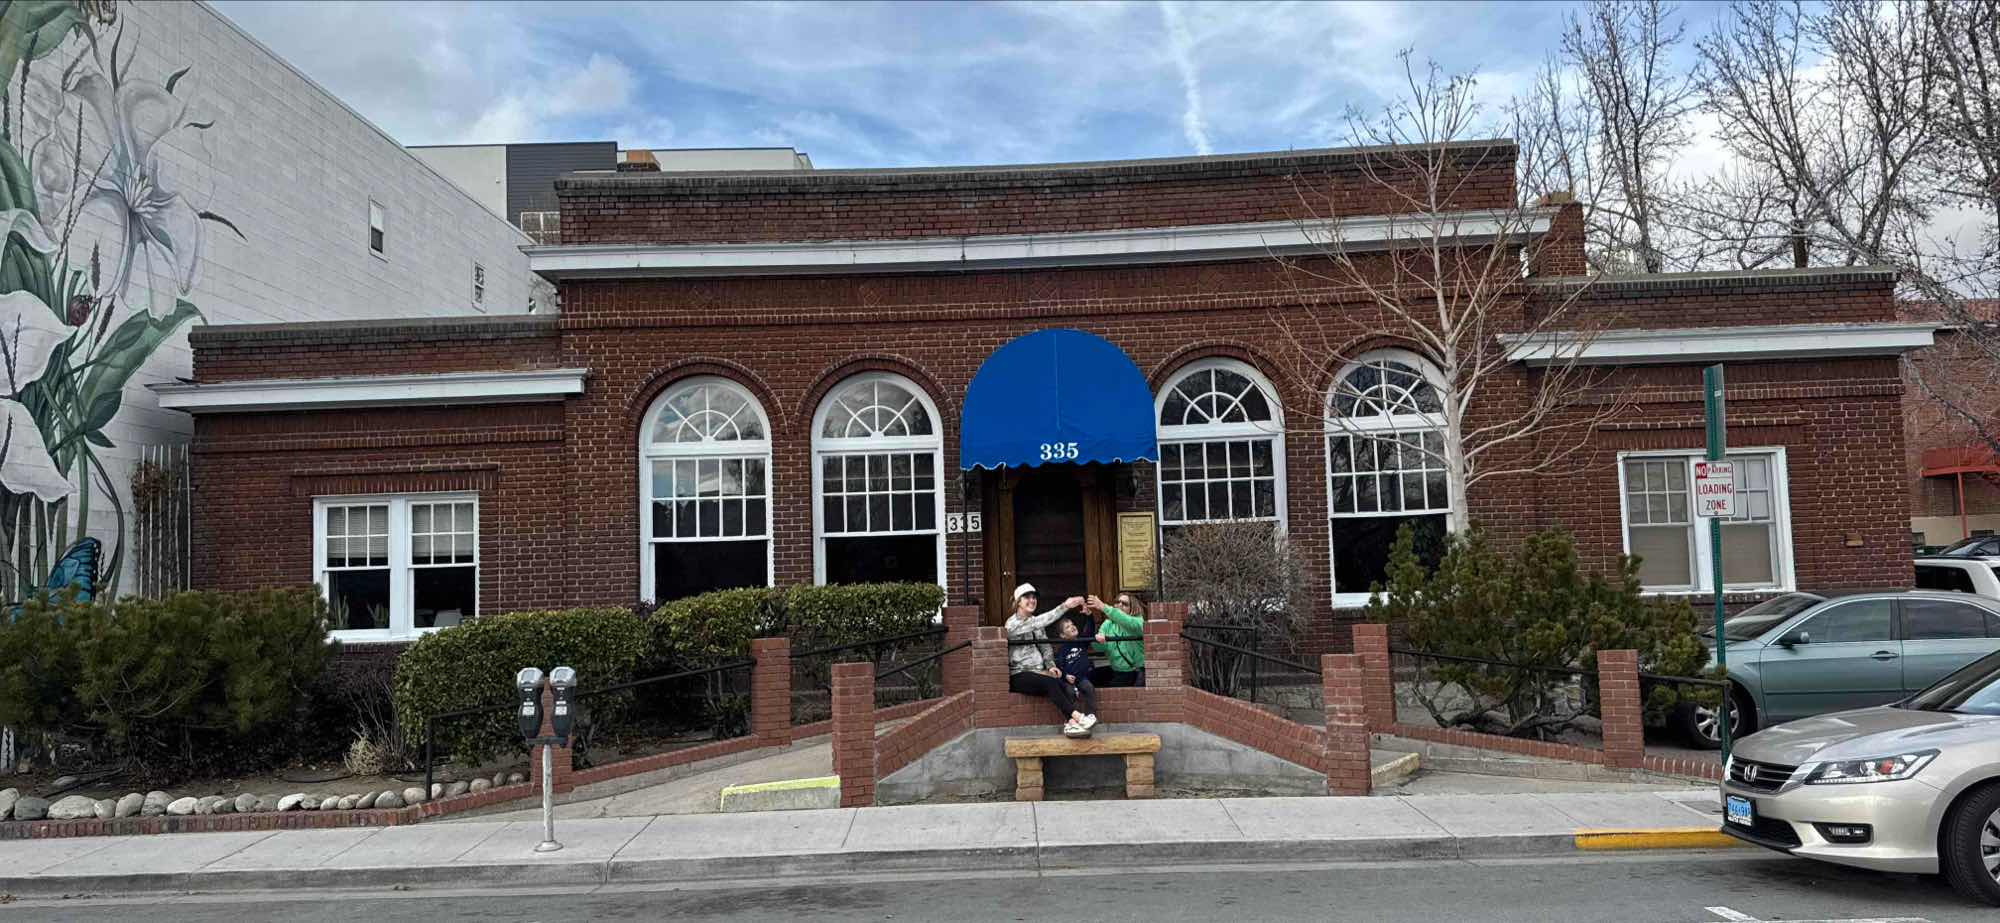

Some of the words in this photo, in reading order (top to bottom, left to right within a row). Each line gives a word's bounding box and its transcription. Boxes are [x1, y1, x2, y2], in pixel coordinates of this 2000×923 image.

[1040, 442, 1079, 460] 335
[1696, 465, 1707, 477] NO
[1698, 484, 1732, 495] LOADING
[1705, 500, 1728, 510] ZONE
